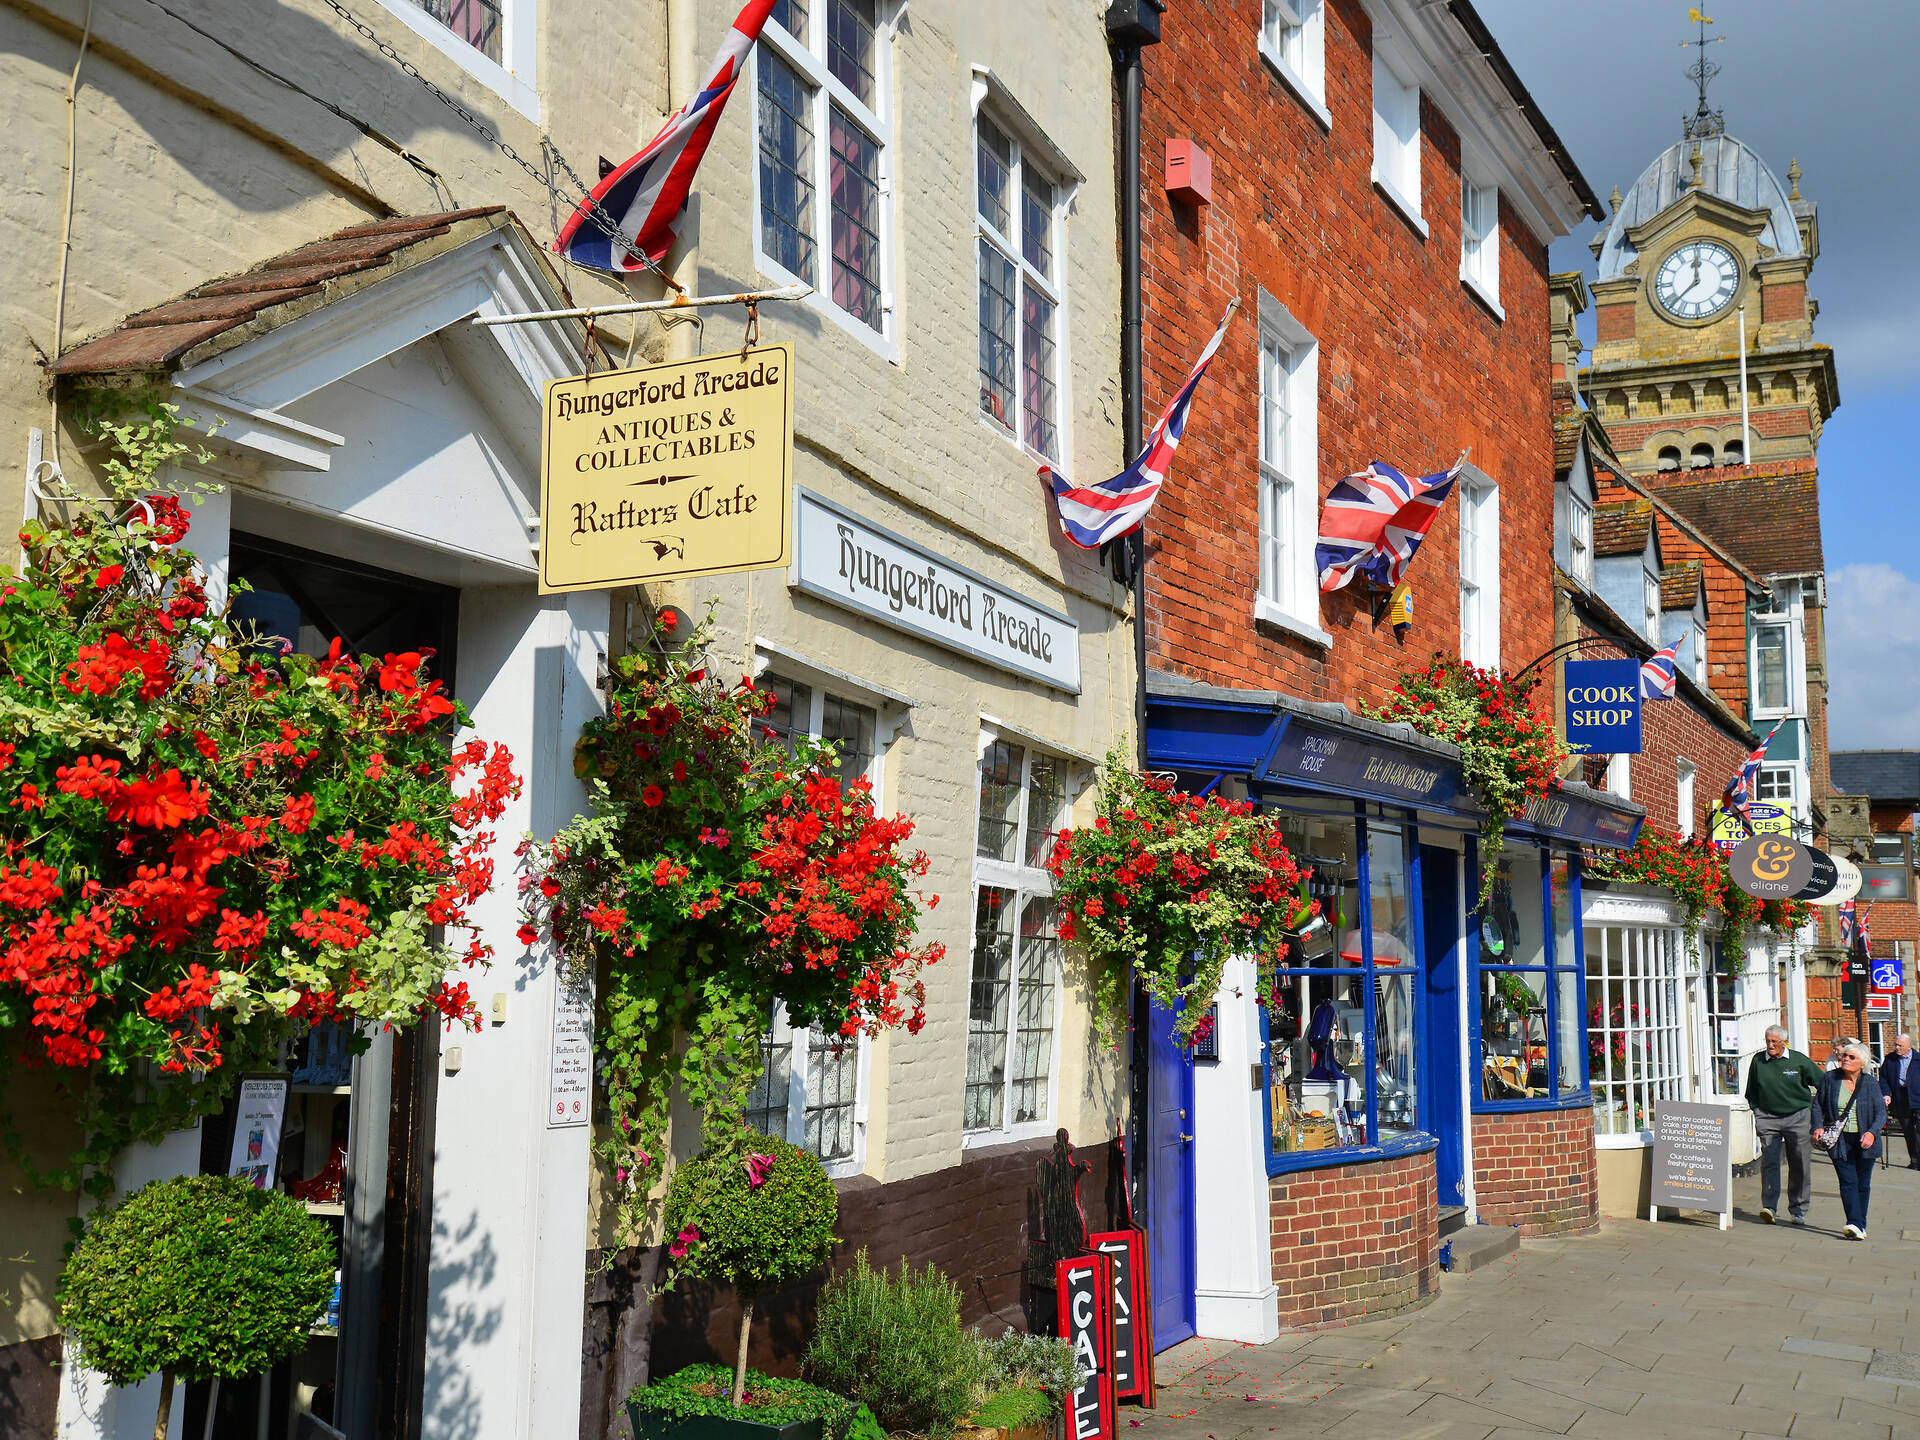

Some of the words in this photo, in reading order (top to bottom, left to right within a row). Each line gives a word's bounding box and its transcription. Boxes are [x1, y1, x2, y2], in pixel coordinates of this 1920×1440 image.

[556, 375, 686, 421] Hungerford
[694, 363, 780, 397] Arcade
[596, 410, 713, 445] ANTIQUES
[718, 407, 736, 426] &
[575, 429, 756, 473] COLLECTABLES
[570, 498, 679, 546] Rafters
[688, 484, 758, 520] Cafe
[837, 523, 972, 631] Hungerford
[982, 592, 1053, 664] Arcade
[1568, 686, 1636, 704] COOK
[1572, 710, 1632, 726] SHOP
[1302, 736, 1338, 756] SPACKMAN
[1300, 754, 1325, 772] HOUSE
[1363, 757, 1382, 780] Tel:
[1380, 762, 1409, 787] 01488
[1724, 820, 1781, 830] OFCES
[1750, 880, 1789, 892] eliane
[1668, 1160, 1688, 1168] freshly
[1687, 1176, 1711, 1184] serving
